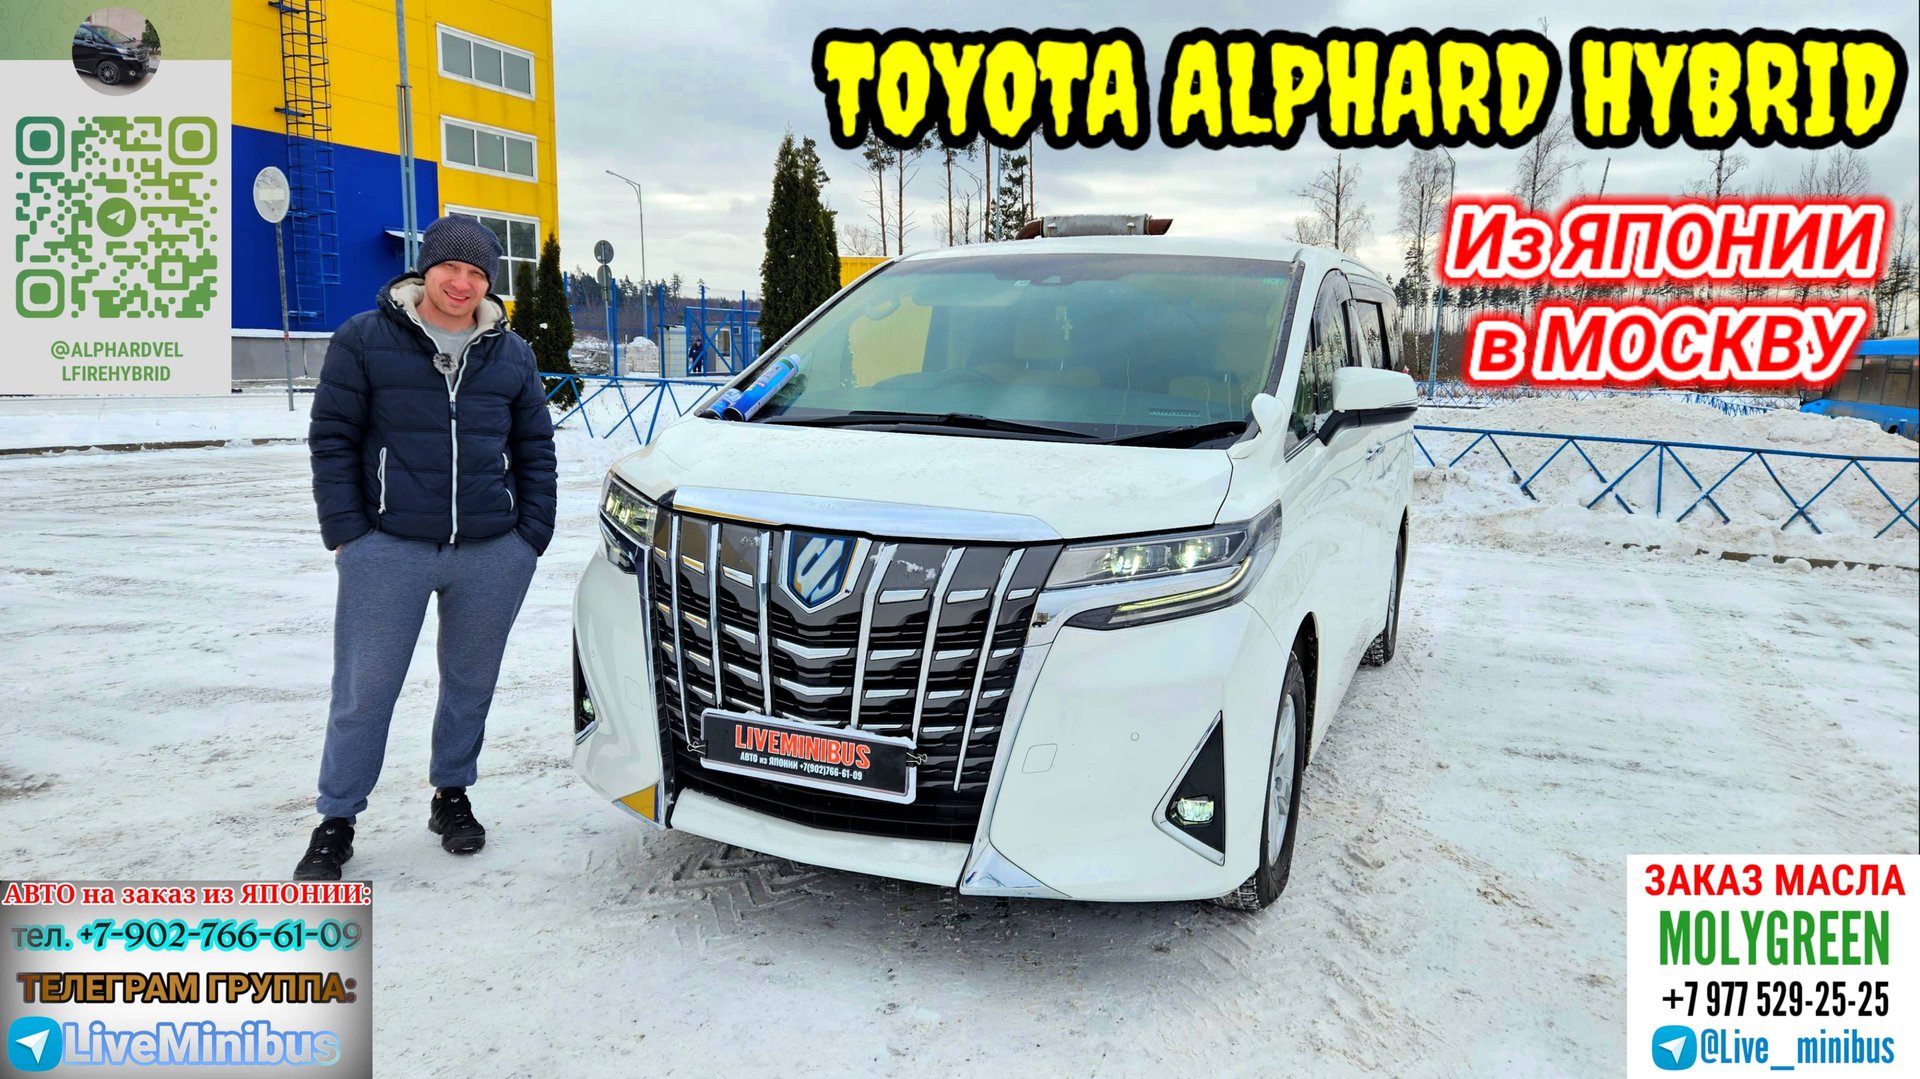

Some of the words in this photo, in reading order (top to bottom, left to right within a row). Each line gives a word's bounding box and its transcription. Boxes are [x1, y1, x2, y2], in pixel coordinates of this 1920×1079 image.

[735, 724, 871, 769] LIVEMINIBUS
[740, 751, 758, 763] АВТО
[768, 757, 798, 769] ЯПОНИИ
[799, 763, 863, 781] +7(902)766-61-09
